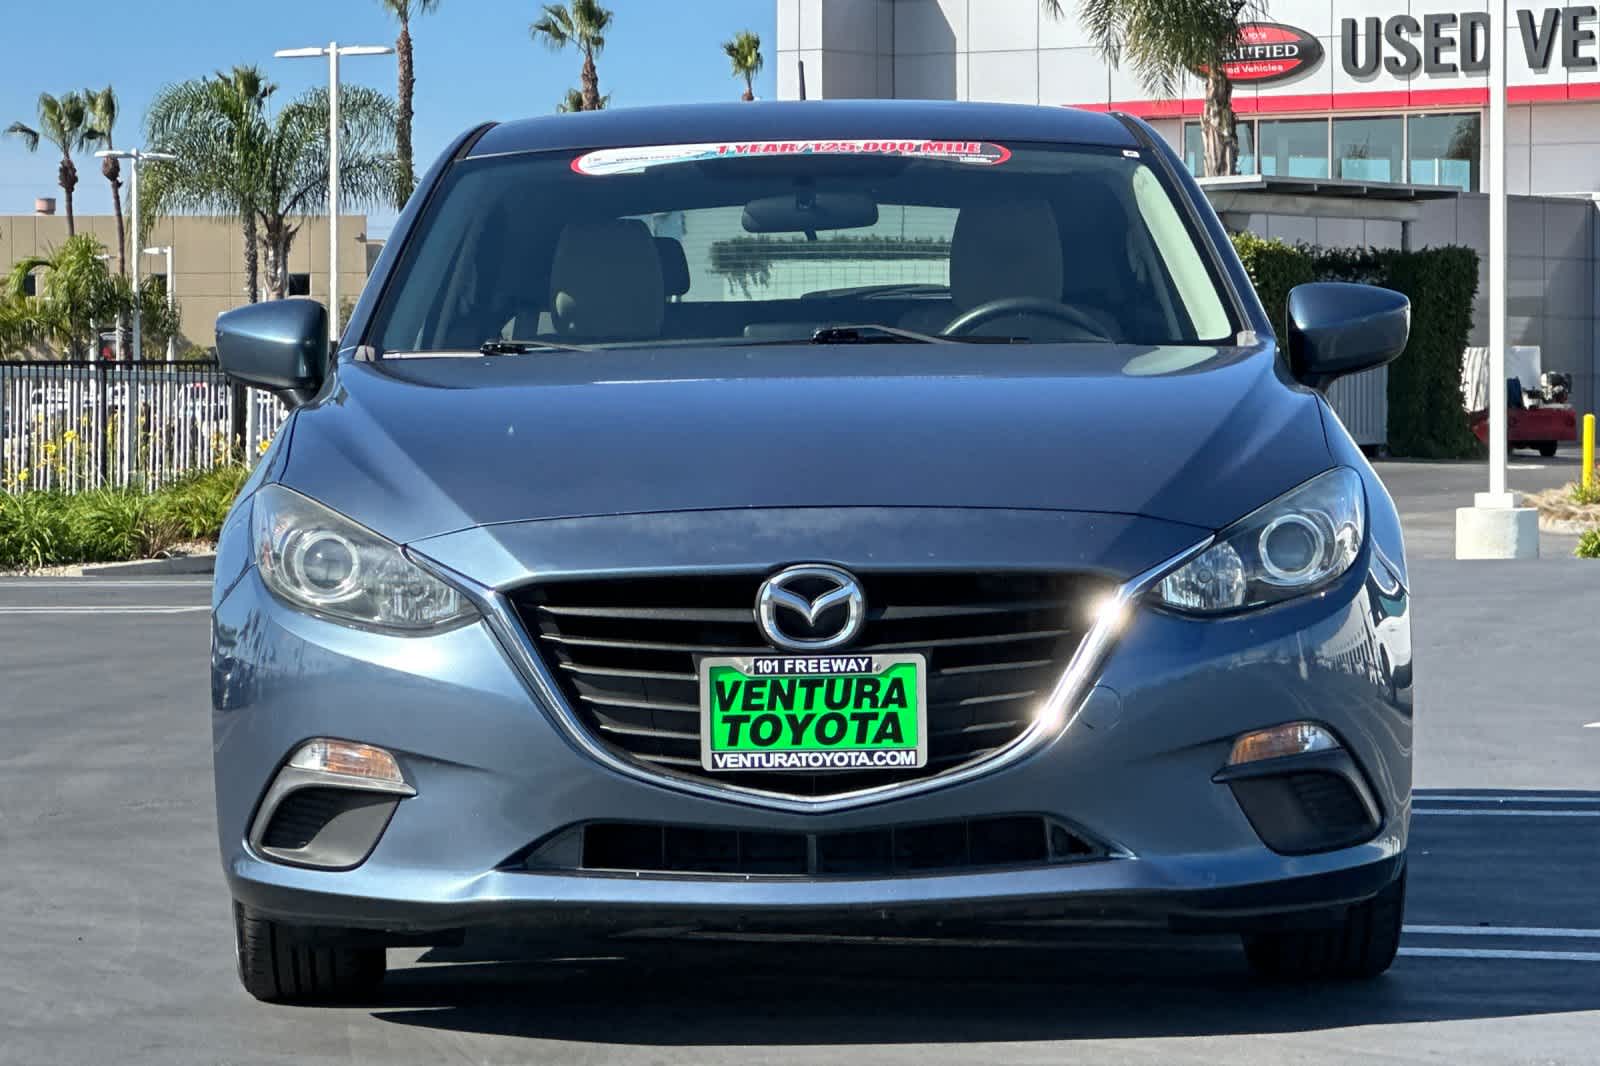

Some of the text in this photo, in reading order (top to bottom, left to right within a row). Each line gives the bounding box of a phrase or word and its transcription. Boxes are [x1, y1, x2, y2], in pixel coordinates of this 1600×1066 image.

[1341, 6, 1600, 78] USED VE
[1241, 63, 1284, 73] Vehicles
[716, 145, 729, 155] 1
[921, 142, 981, 154] MILE
[756, 659, 869, 673] 101 FREEWAY
[715, 678, 908, 711] VENTURA
[722, 712, 904, 746] TOYOTA
[714, 751, 915, 768] VENTURATOYOTA.COM
